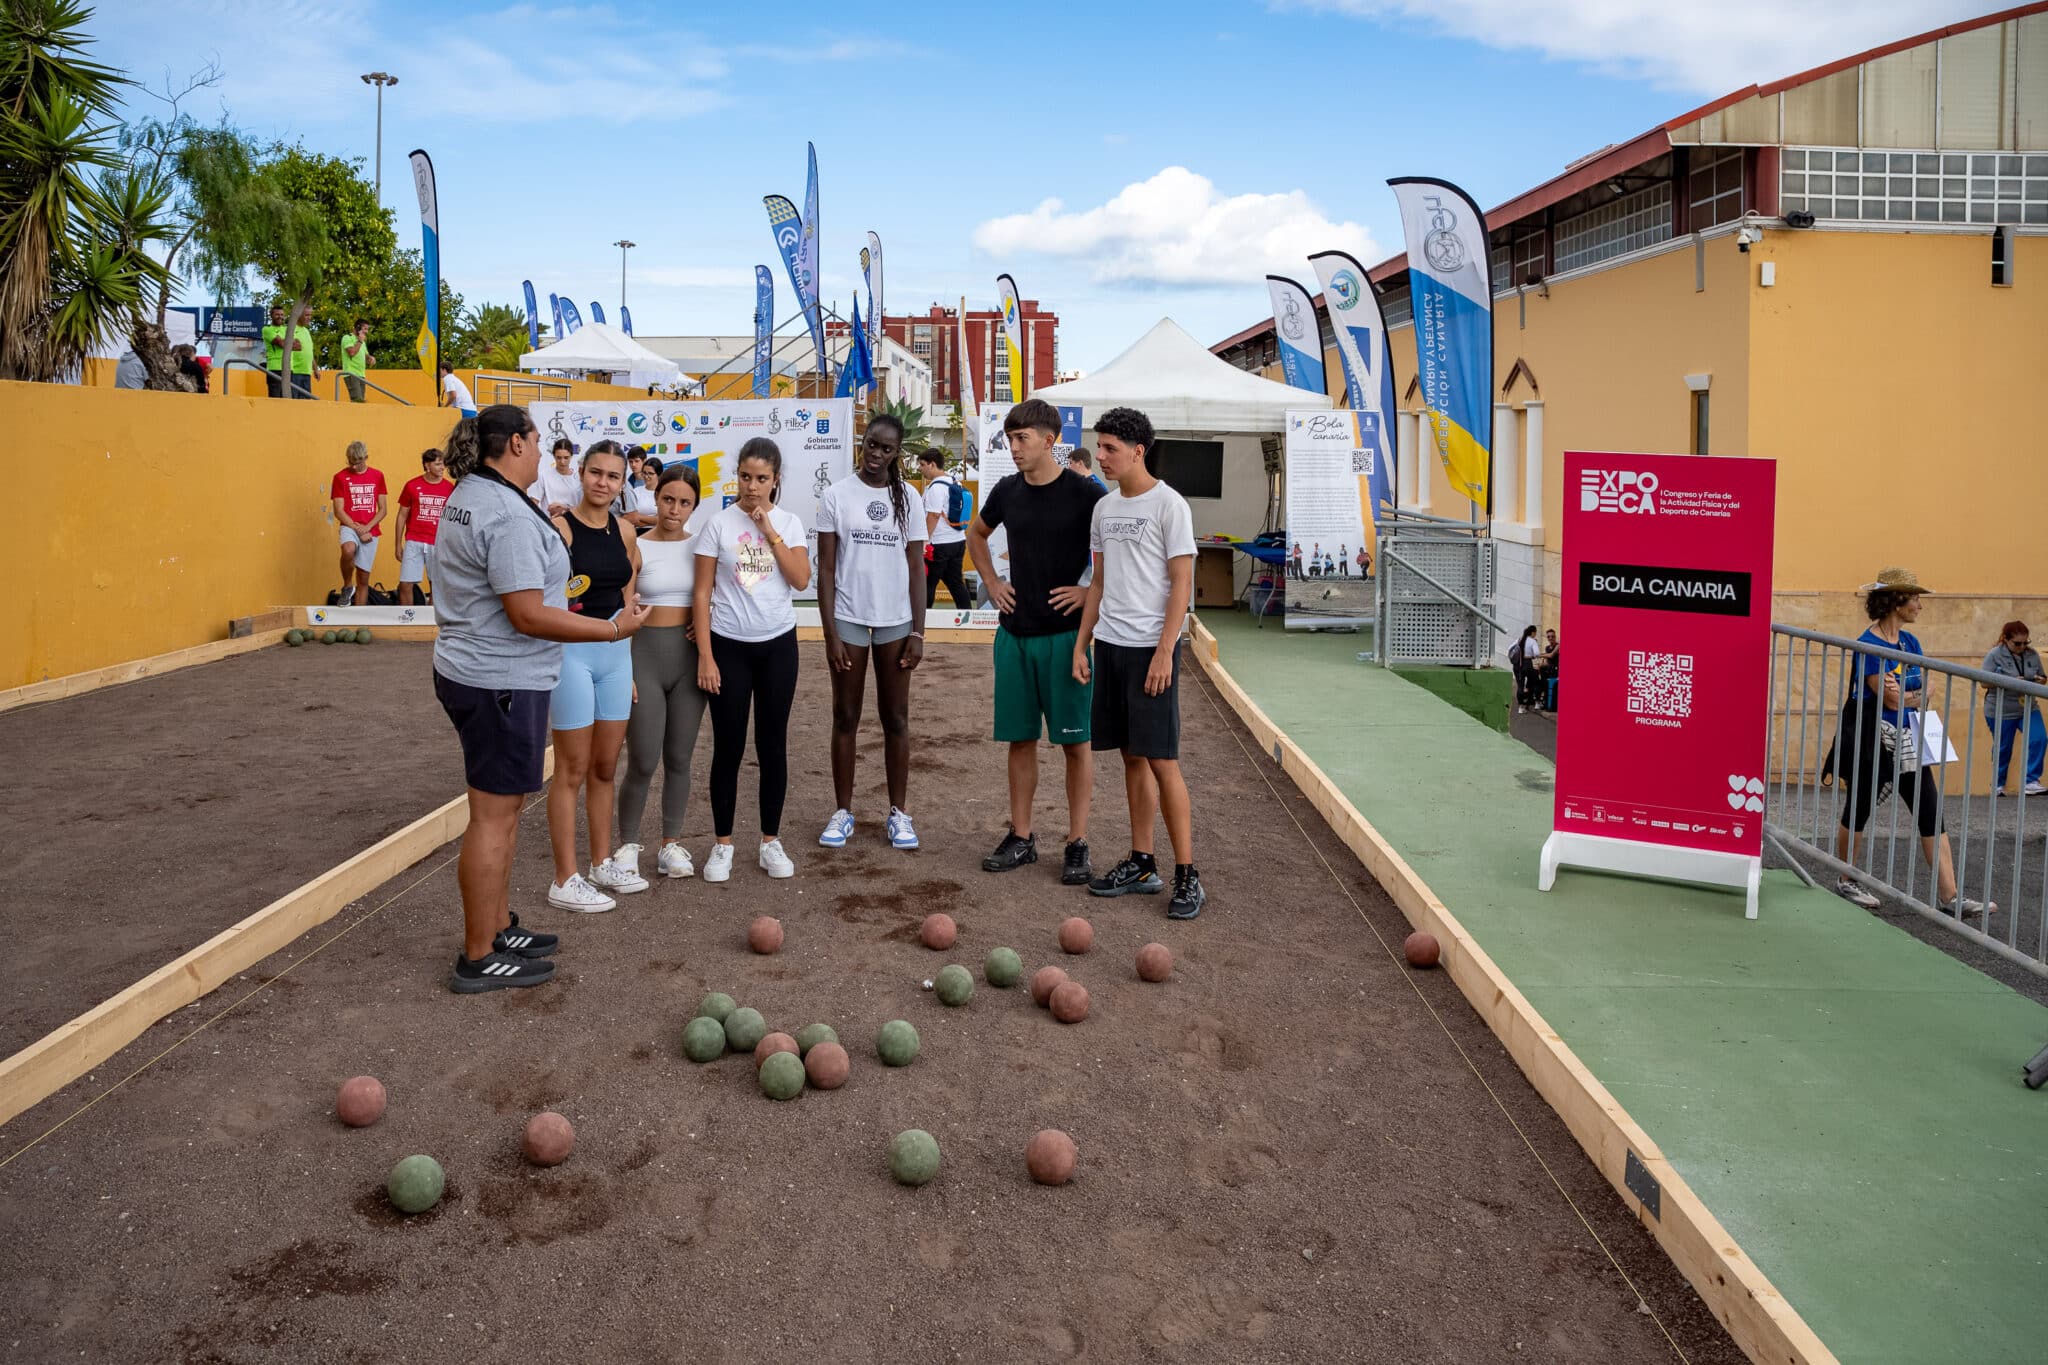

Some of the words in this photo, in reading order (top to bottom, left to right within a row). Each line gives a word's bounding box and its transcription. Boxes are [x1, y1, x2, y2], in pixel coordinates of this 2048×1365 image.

[1308, 415, 1345, 436] Bola
[1313, 432, 1351, 440] canaria
[1581, 469, 1659, 493] EXPO
[1663, 490, 1697, 499] Congreso
[1703, 491, 1721, 499] Feria
[1722, 492, 1732, 500] de
[1581, 490, 1656, 515] DECA
[1667, 499, 1700, 507] Actividad
[1728, 501, 1740, 509] del
[1660, 507, 1688, 516] Deporte
[1699, 509, 1731, 517] Canarias
[851, 532, 881, 541] WORLD
[882, 534, 900, 542] CUP
[740, 544, 764, 556] Art
[735, 561, 773, 573] Motion
[1592, 575, 1645, 594] BOLA
[1649, 578, 1737, 600] CANARIA
[1635, 716, 1682, 728] PROGRAMA
